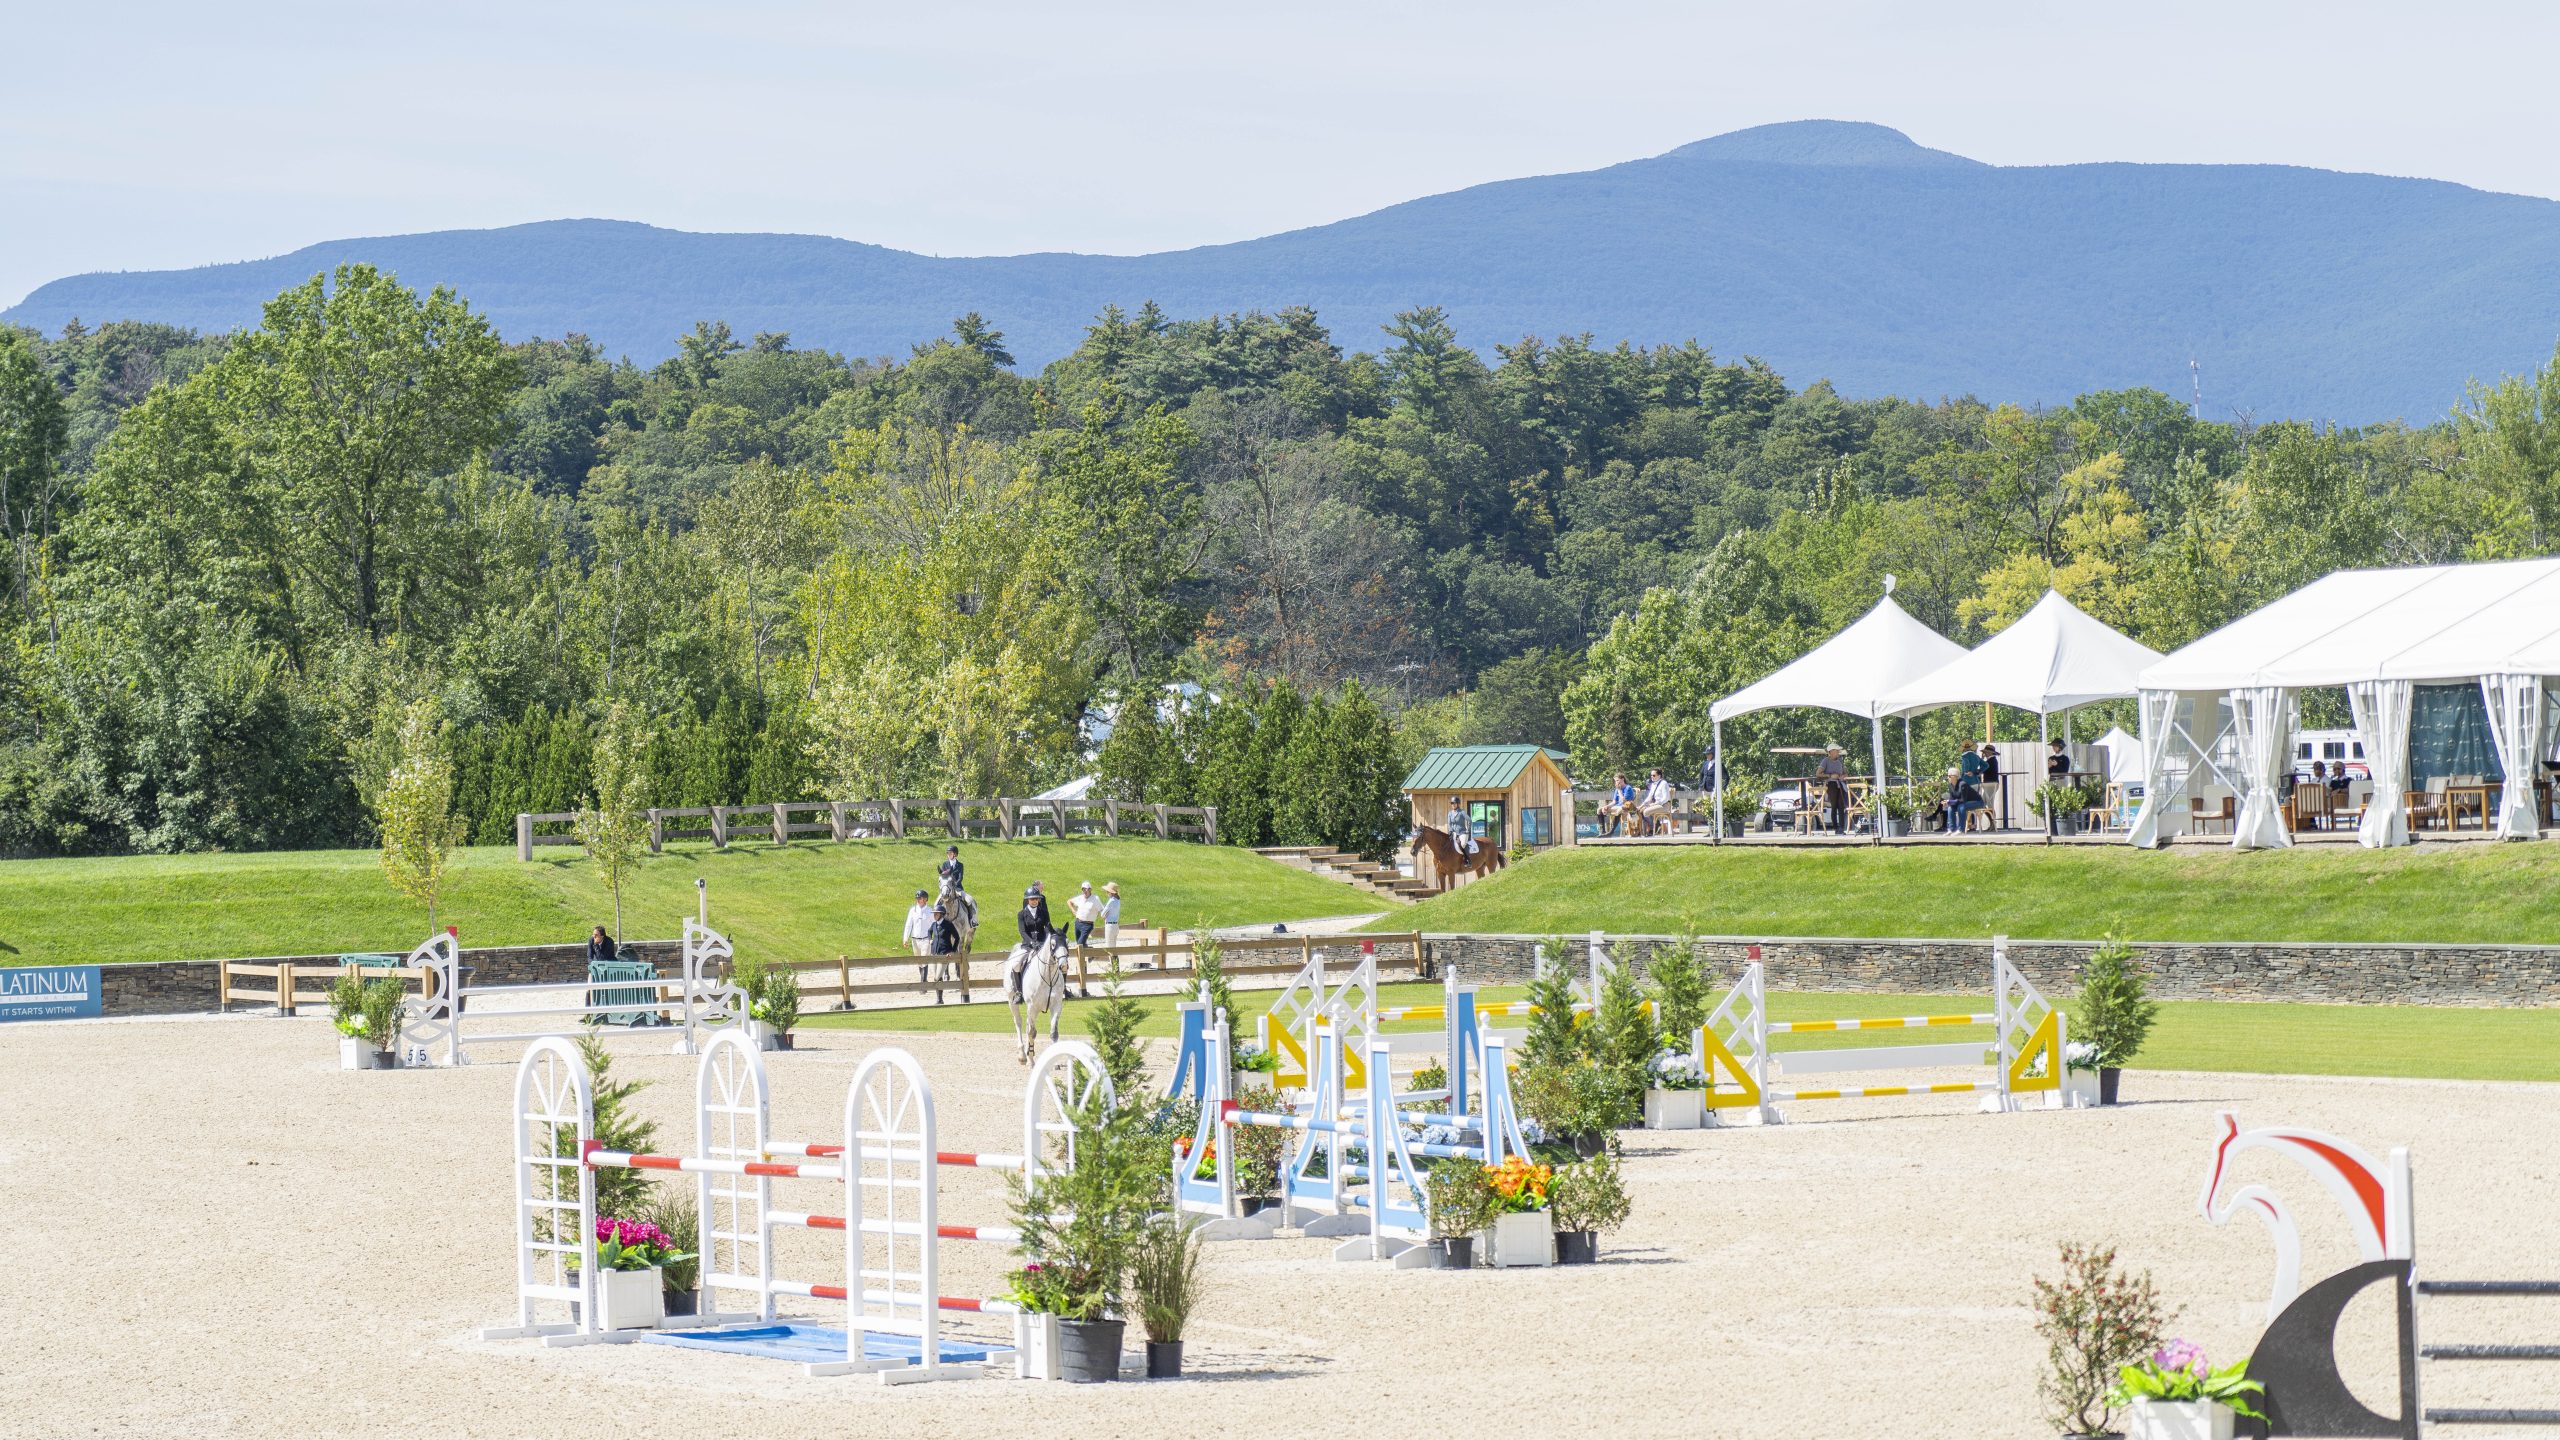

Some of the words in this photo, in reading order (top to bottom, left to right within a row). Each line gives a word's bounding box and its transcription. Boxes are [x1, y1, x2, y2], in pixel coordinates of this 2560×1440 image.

[1, 1008, 9, 1016] IT
[11, 1007, 43, 1016] STARTS
[45, 1006, 76, 1015] WITHIN
[408, 1049, 413, 1061] 5
[419, 1049, 427, 1061] 5
